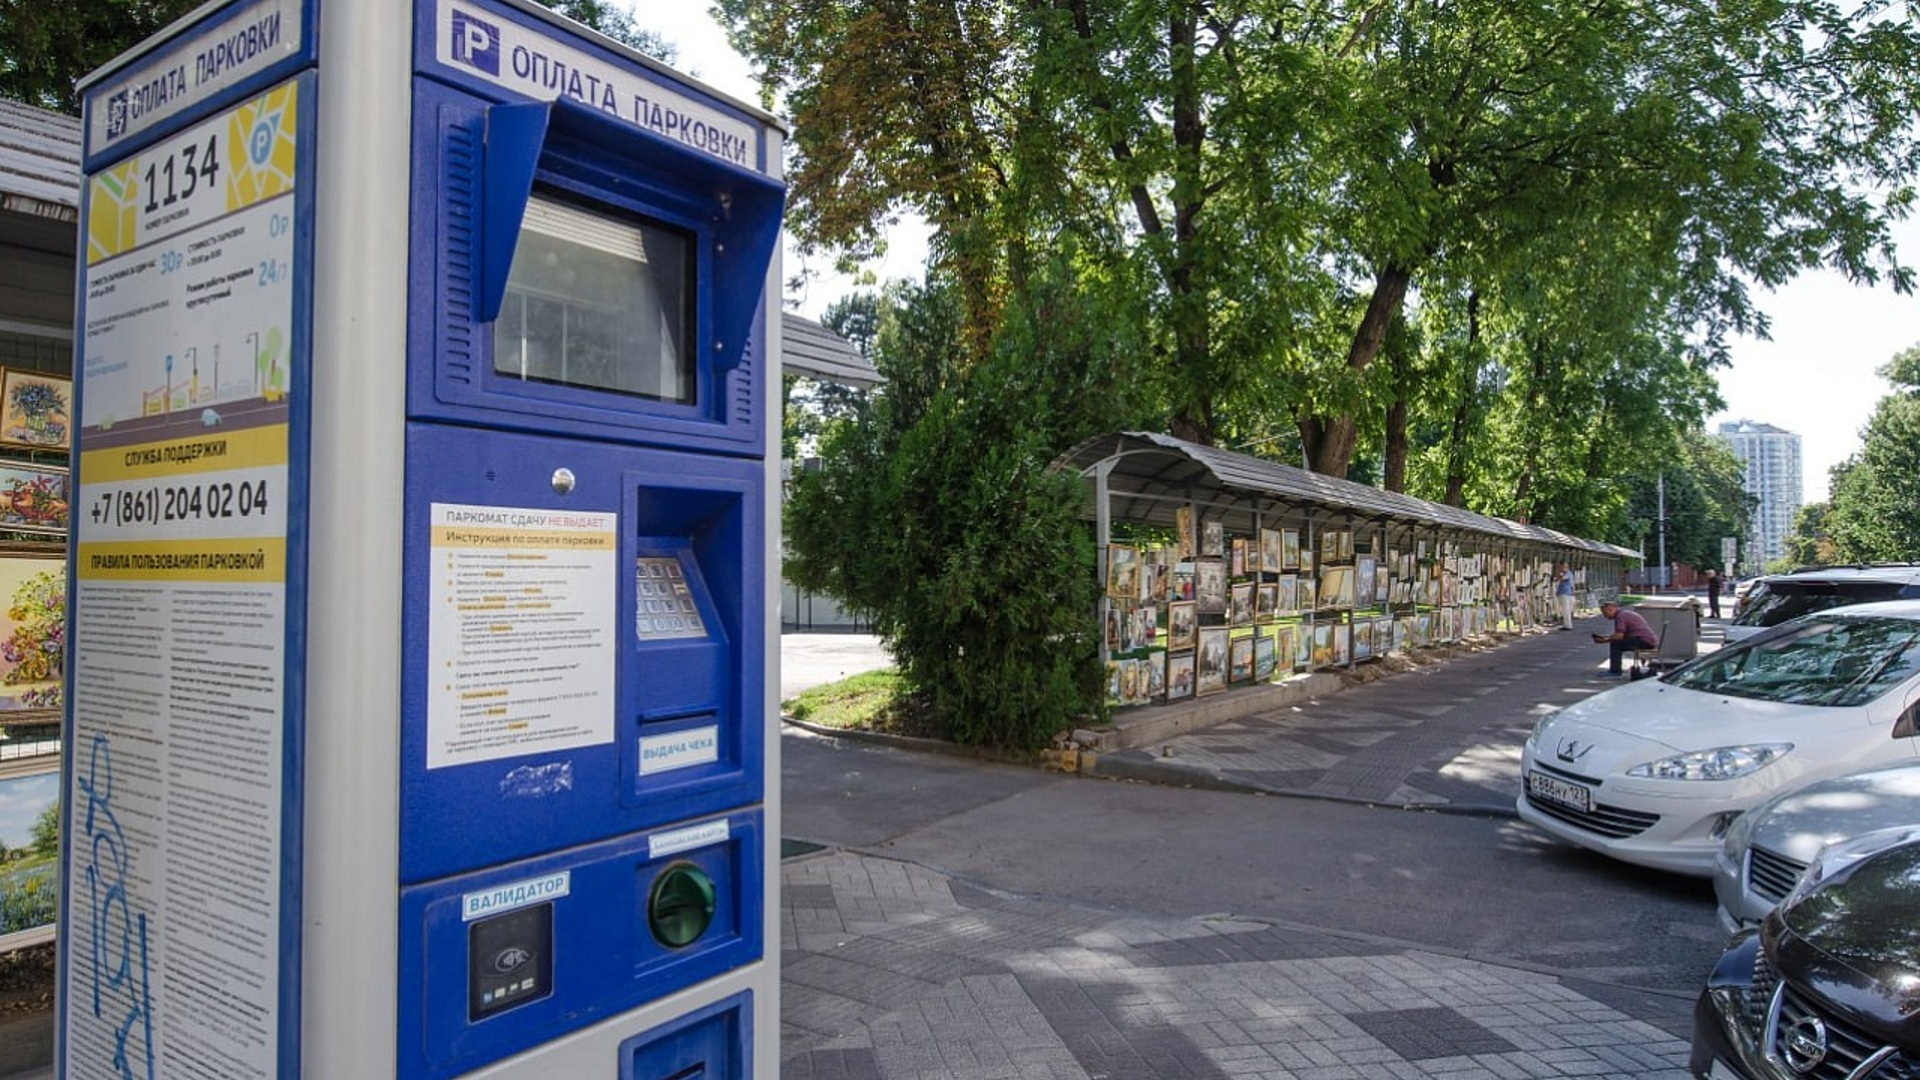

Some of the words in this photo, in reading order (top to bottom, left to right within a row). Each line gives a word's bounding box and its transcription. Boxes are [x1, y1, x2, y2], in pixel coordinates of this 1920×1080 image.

[131, 65, 187, 119] ОПЛАТА
[195, 10, 281, 86] ПАРКОВКИ
[512, 45, 618, 117] ОПЛАТА
[634, 95, 747, 165] ПАРКОВКИ
[144, 134, 219, 213] 1134
[258, 259, 288, 289] 24/7
[125, 448, 163, 467] СЛУЖБА
[163, 439, 228, 464] ПОДДЕРЖКИ
[91, 492, 113, 524] +7
[116, 486, 160, 527] (861)
[164, 485, 202, 521] 204
[207, 482, 234, 518] 02
[238, 479, 268, 517] 04
[447, 510, 509, 523] ПАРКОМАТ
[511, 514, 546, 527] СДАЧУ
[549, 516, 563, 526] НЕ
[564, 517, 605, 528] ВЫДАЕТ
[446, 531, 510, 545] Инструкция
[513, 535, 525, 543] по
[526, 535, 560, 545] оплате
[562, 537, 605, 547] парковки
[91, 554, 130, 569] ПРАВИЛА
[131, 553, 200, 569] ПОЛЬЗОВАНИЯ
[200, 548, 265, 569] ПАРКОВКОЙ
[643, 744, 687, 759] ВЫДАЧА
[688, 737, 713, 751] ЧЕКА
[469, 876, 565, 913] ВАЛИДАТОР
